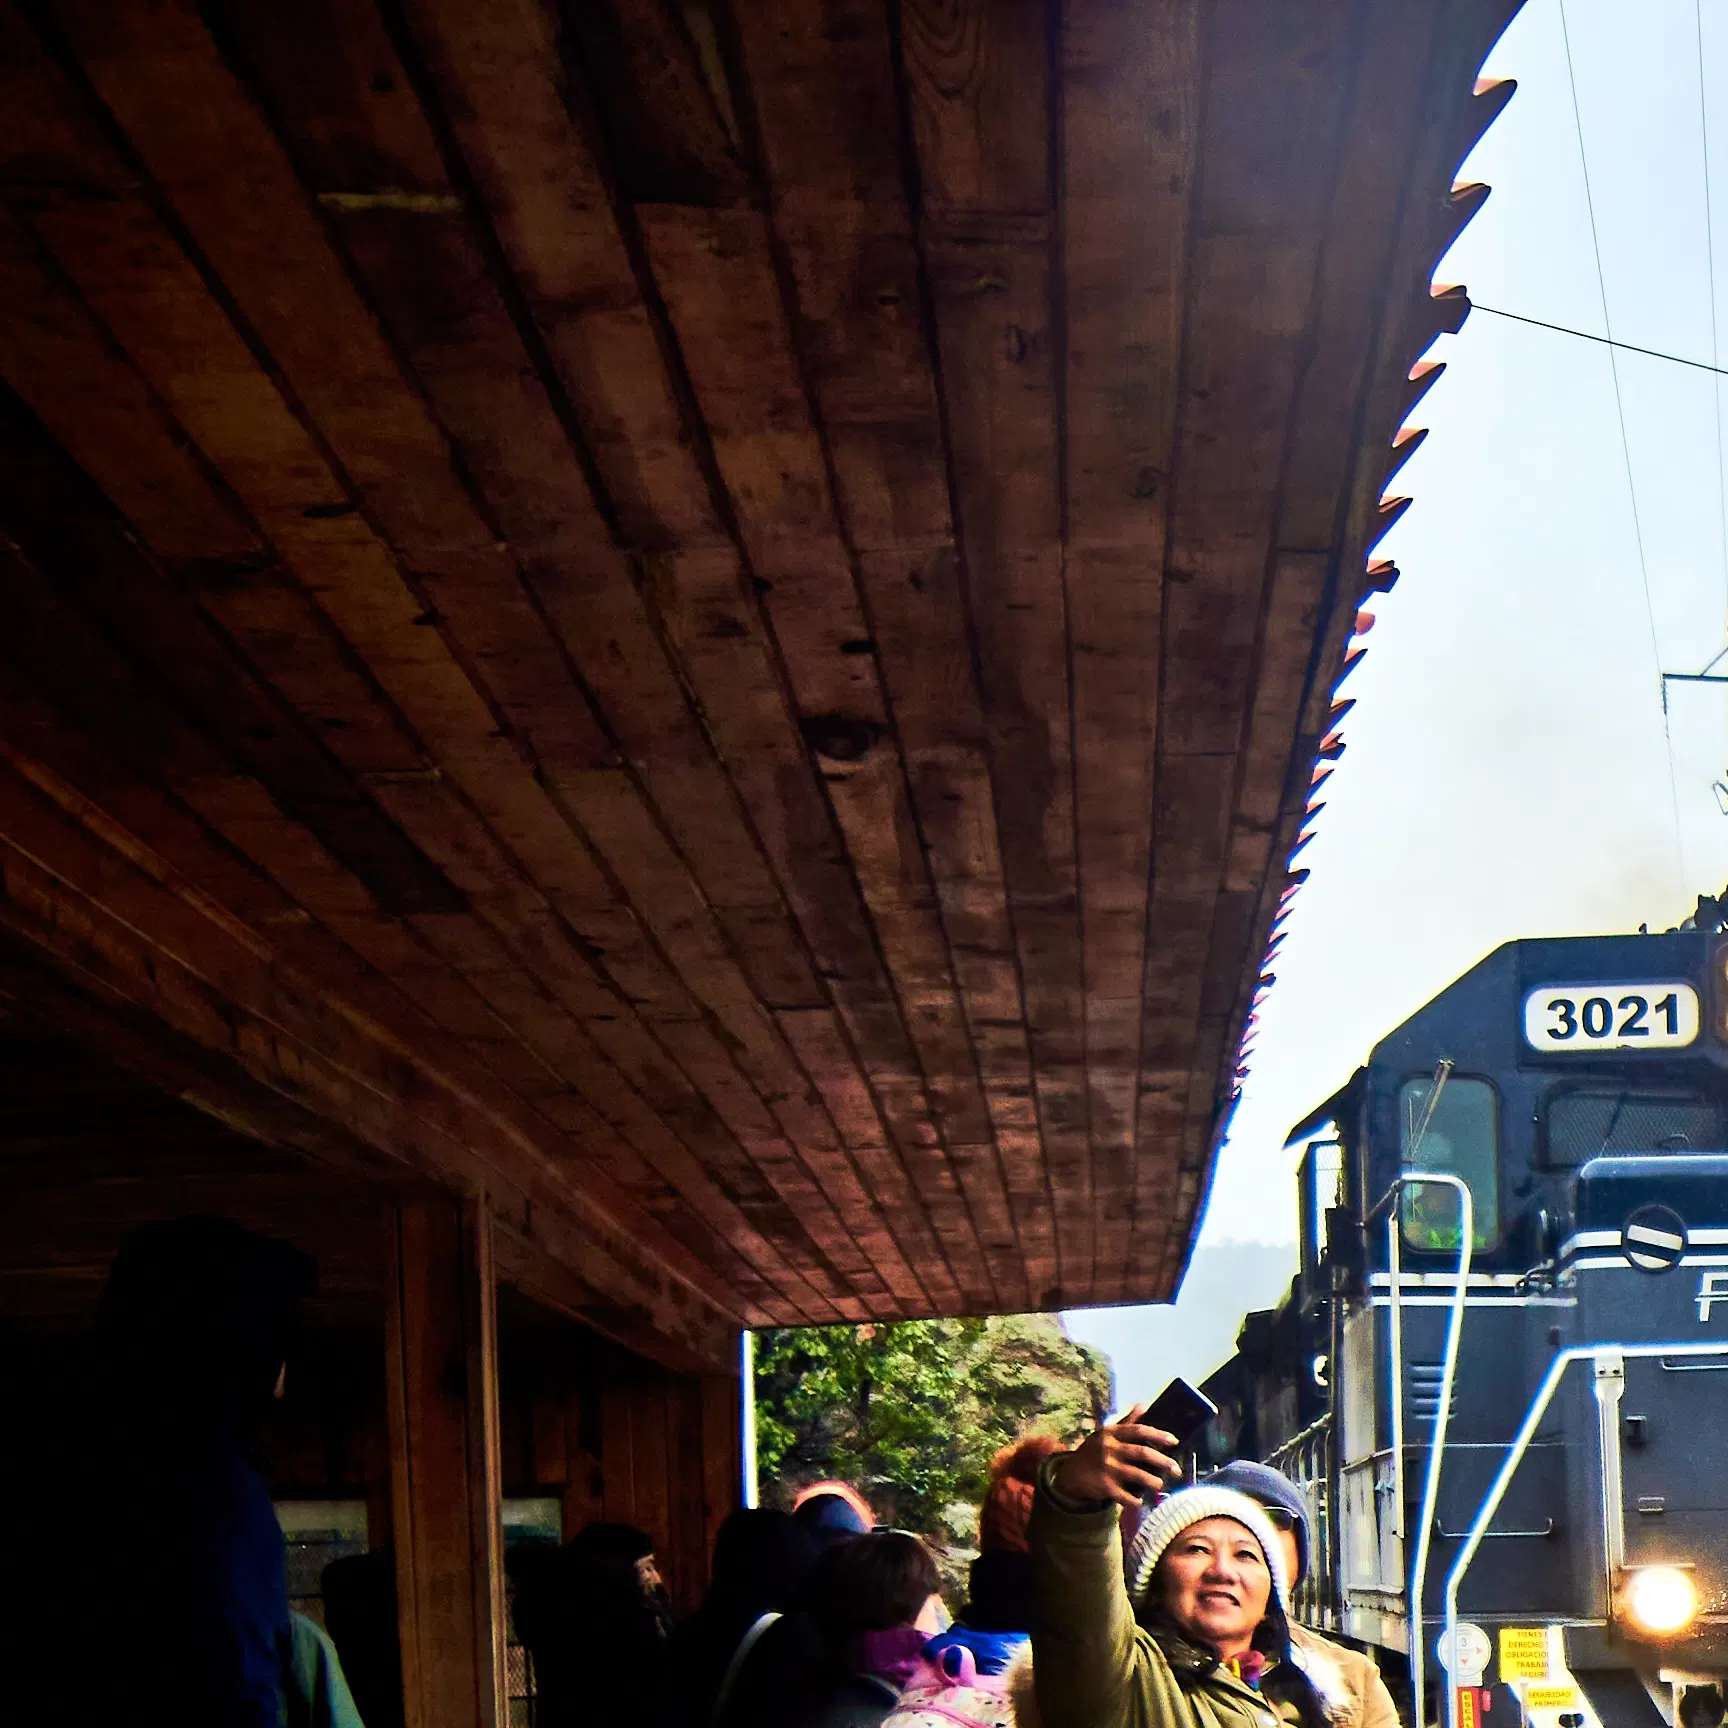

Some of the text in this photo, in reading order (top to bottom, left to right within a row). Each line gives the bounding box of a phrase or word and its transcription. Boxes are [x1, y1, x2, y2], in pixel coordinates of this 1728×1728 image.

[1546, 993, 1680, 1041] 3021
[1461, 1637, 1468, 1648] 3
[1505, 1651, 1548, 1659] OBLIGACIO
[1527, 1691, 1571, 1699] SEGURIDAD
